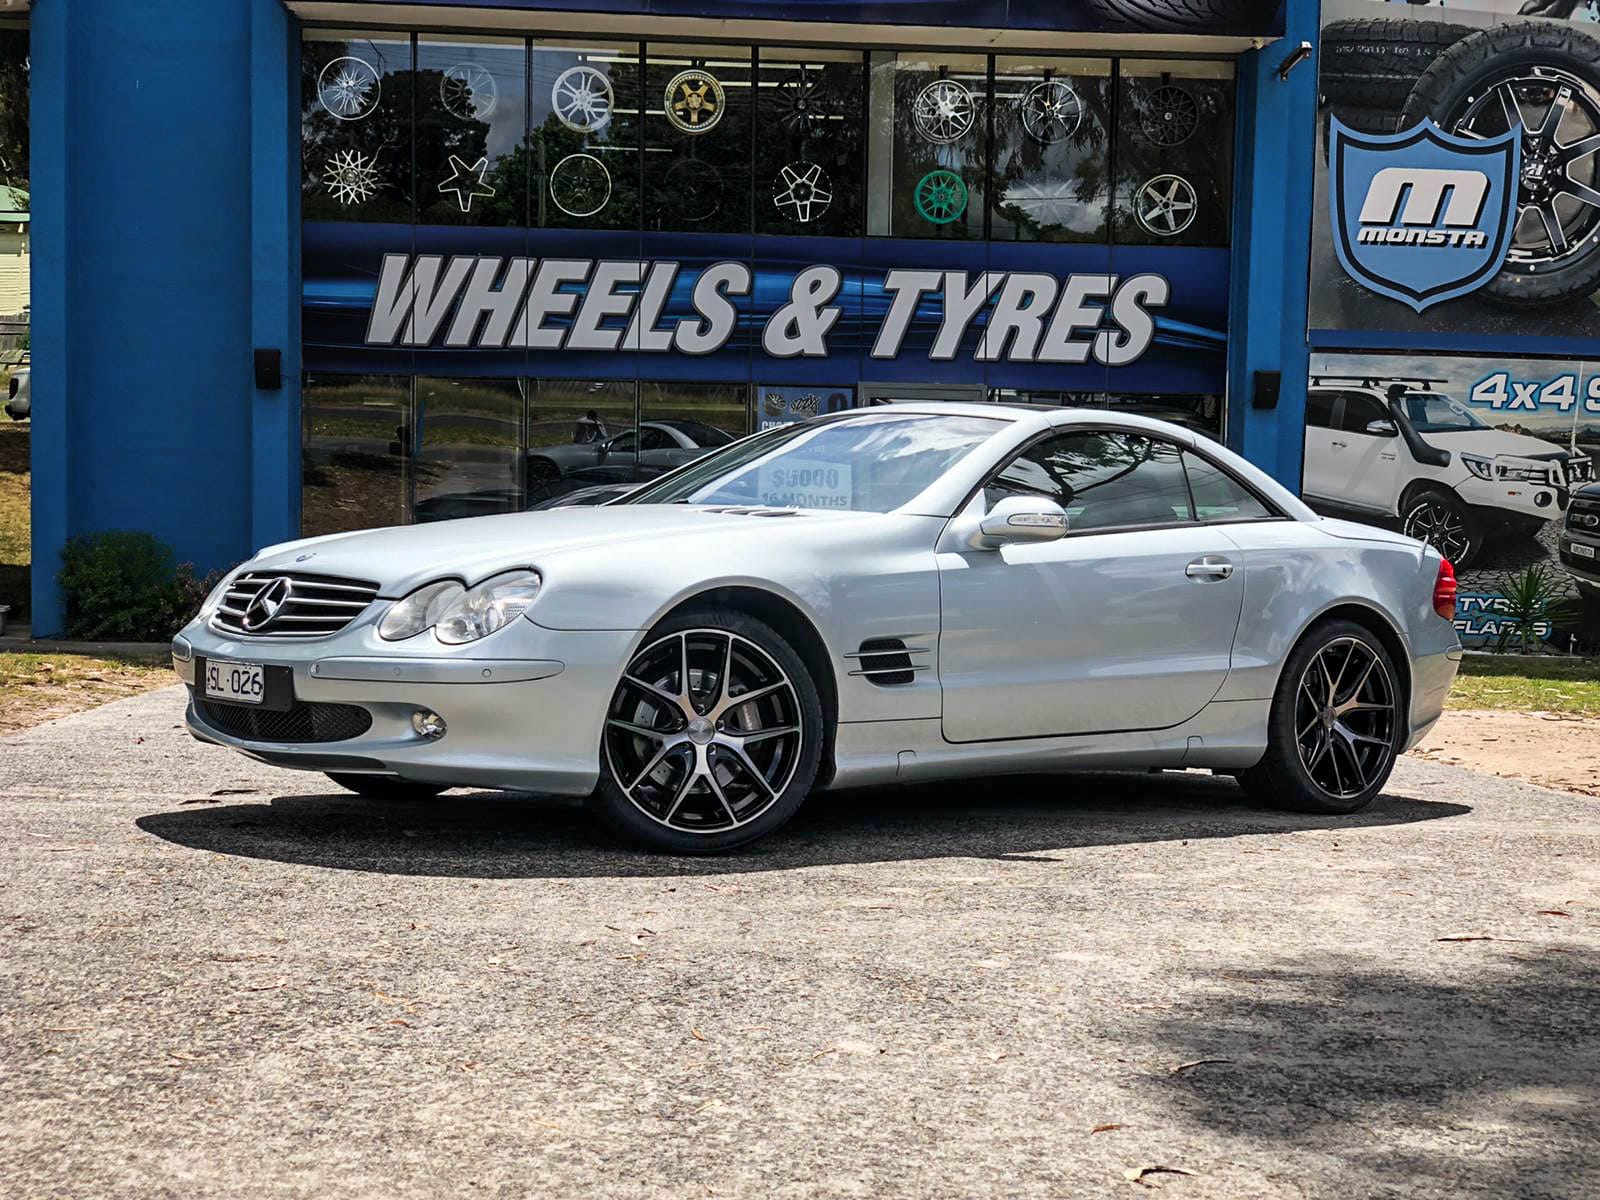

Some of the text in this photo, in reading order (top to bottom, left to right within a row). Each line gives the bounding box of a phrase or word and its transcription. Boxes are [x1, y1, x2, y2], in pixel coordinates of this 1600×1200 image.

[1356, 226, 1488, 249] MONSTA
[365, 253, 1169, 366] WHEELS & TYRES
[1471, 372, 1577, 412] 4x4
[1459, 597, 1542, 613] TYR
[1453, 620, 1548, 636] FLAS
